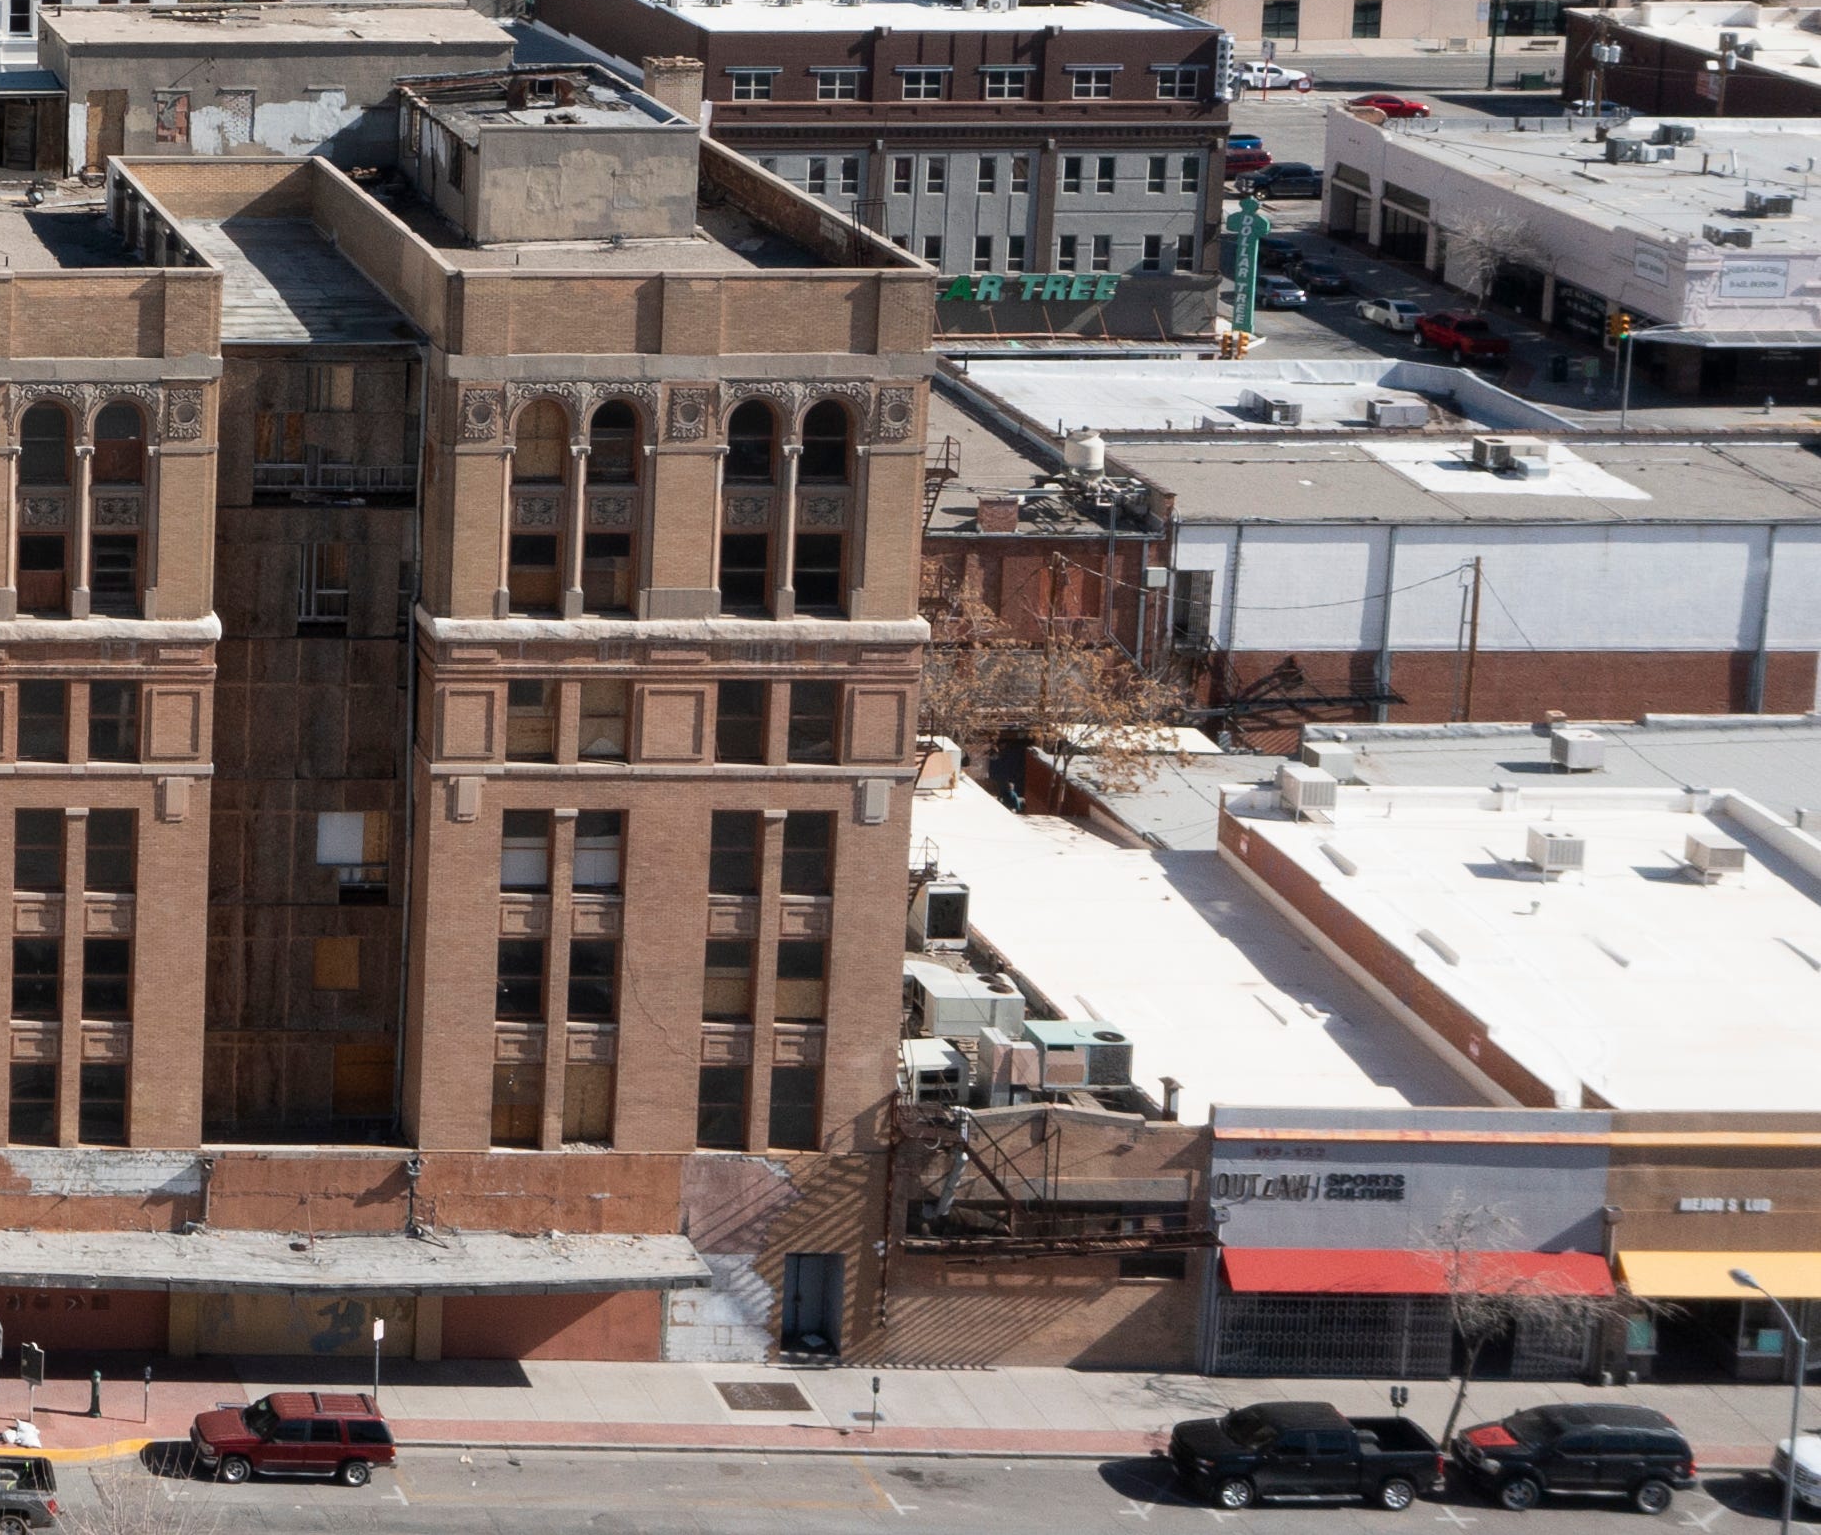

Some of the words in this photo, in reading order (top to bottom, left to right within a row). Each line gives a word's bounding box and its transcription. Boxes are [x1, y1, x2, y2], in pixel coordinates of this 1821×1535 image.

[1238, 215, 1253, 278] DOLLAR
[936, 273, 1005, 301] AR
[1018, 273, 1122, 301] TREE
[1235, 283, 1247, 324] TREE
[1324, 1187, 1405, 1201] CULTURE
[1326, 1173, 1406, 1187] SPORTS
